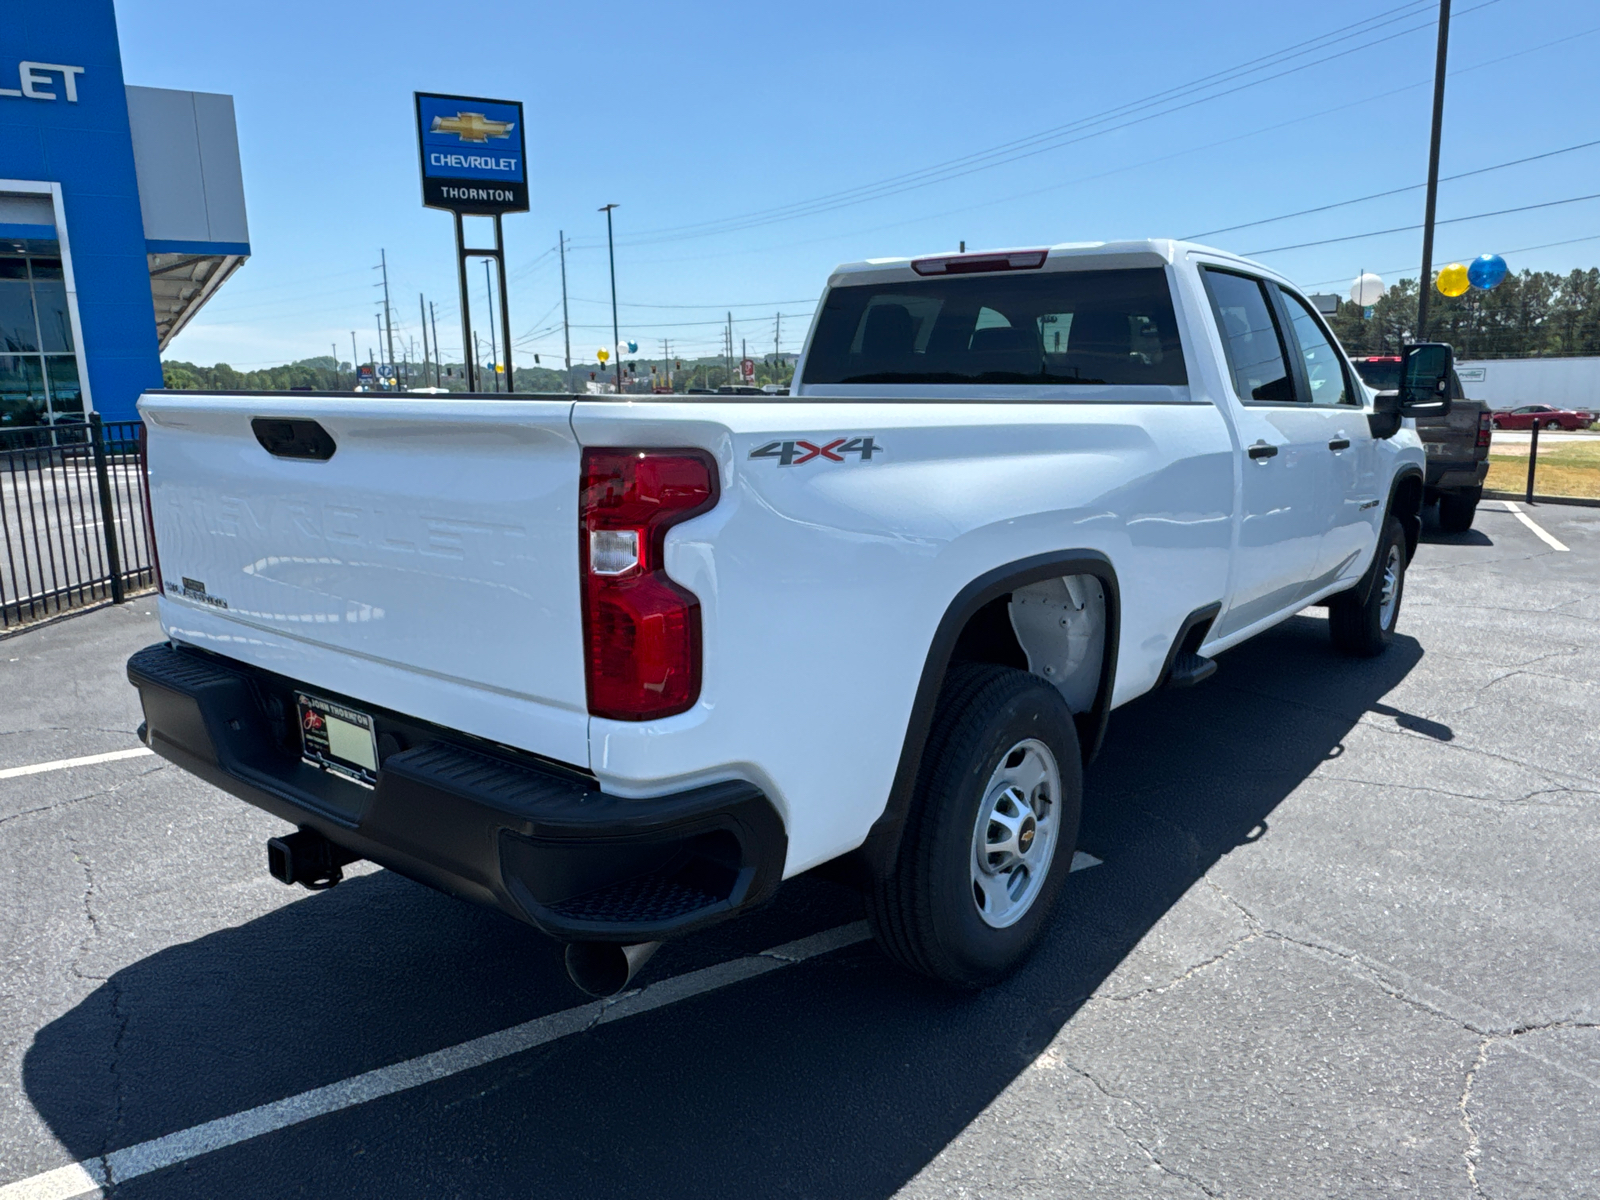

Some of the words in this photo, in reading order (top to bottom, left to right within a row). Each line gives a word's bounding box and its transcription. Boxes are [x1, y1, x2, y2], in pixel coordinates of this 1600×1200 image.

[430, 153, 517, 171] CHEVROLET
[441, 186, 514, 202] THORNTON
[311, 699, 330, 711] JOHN
